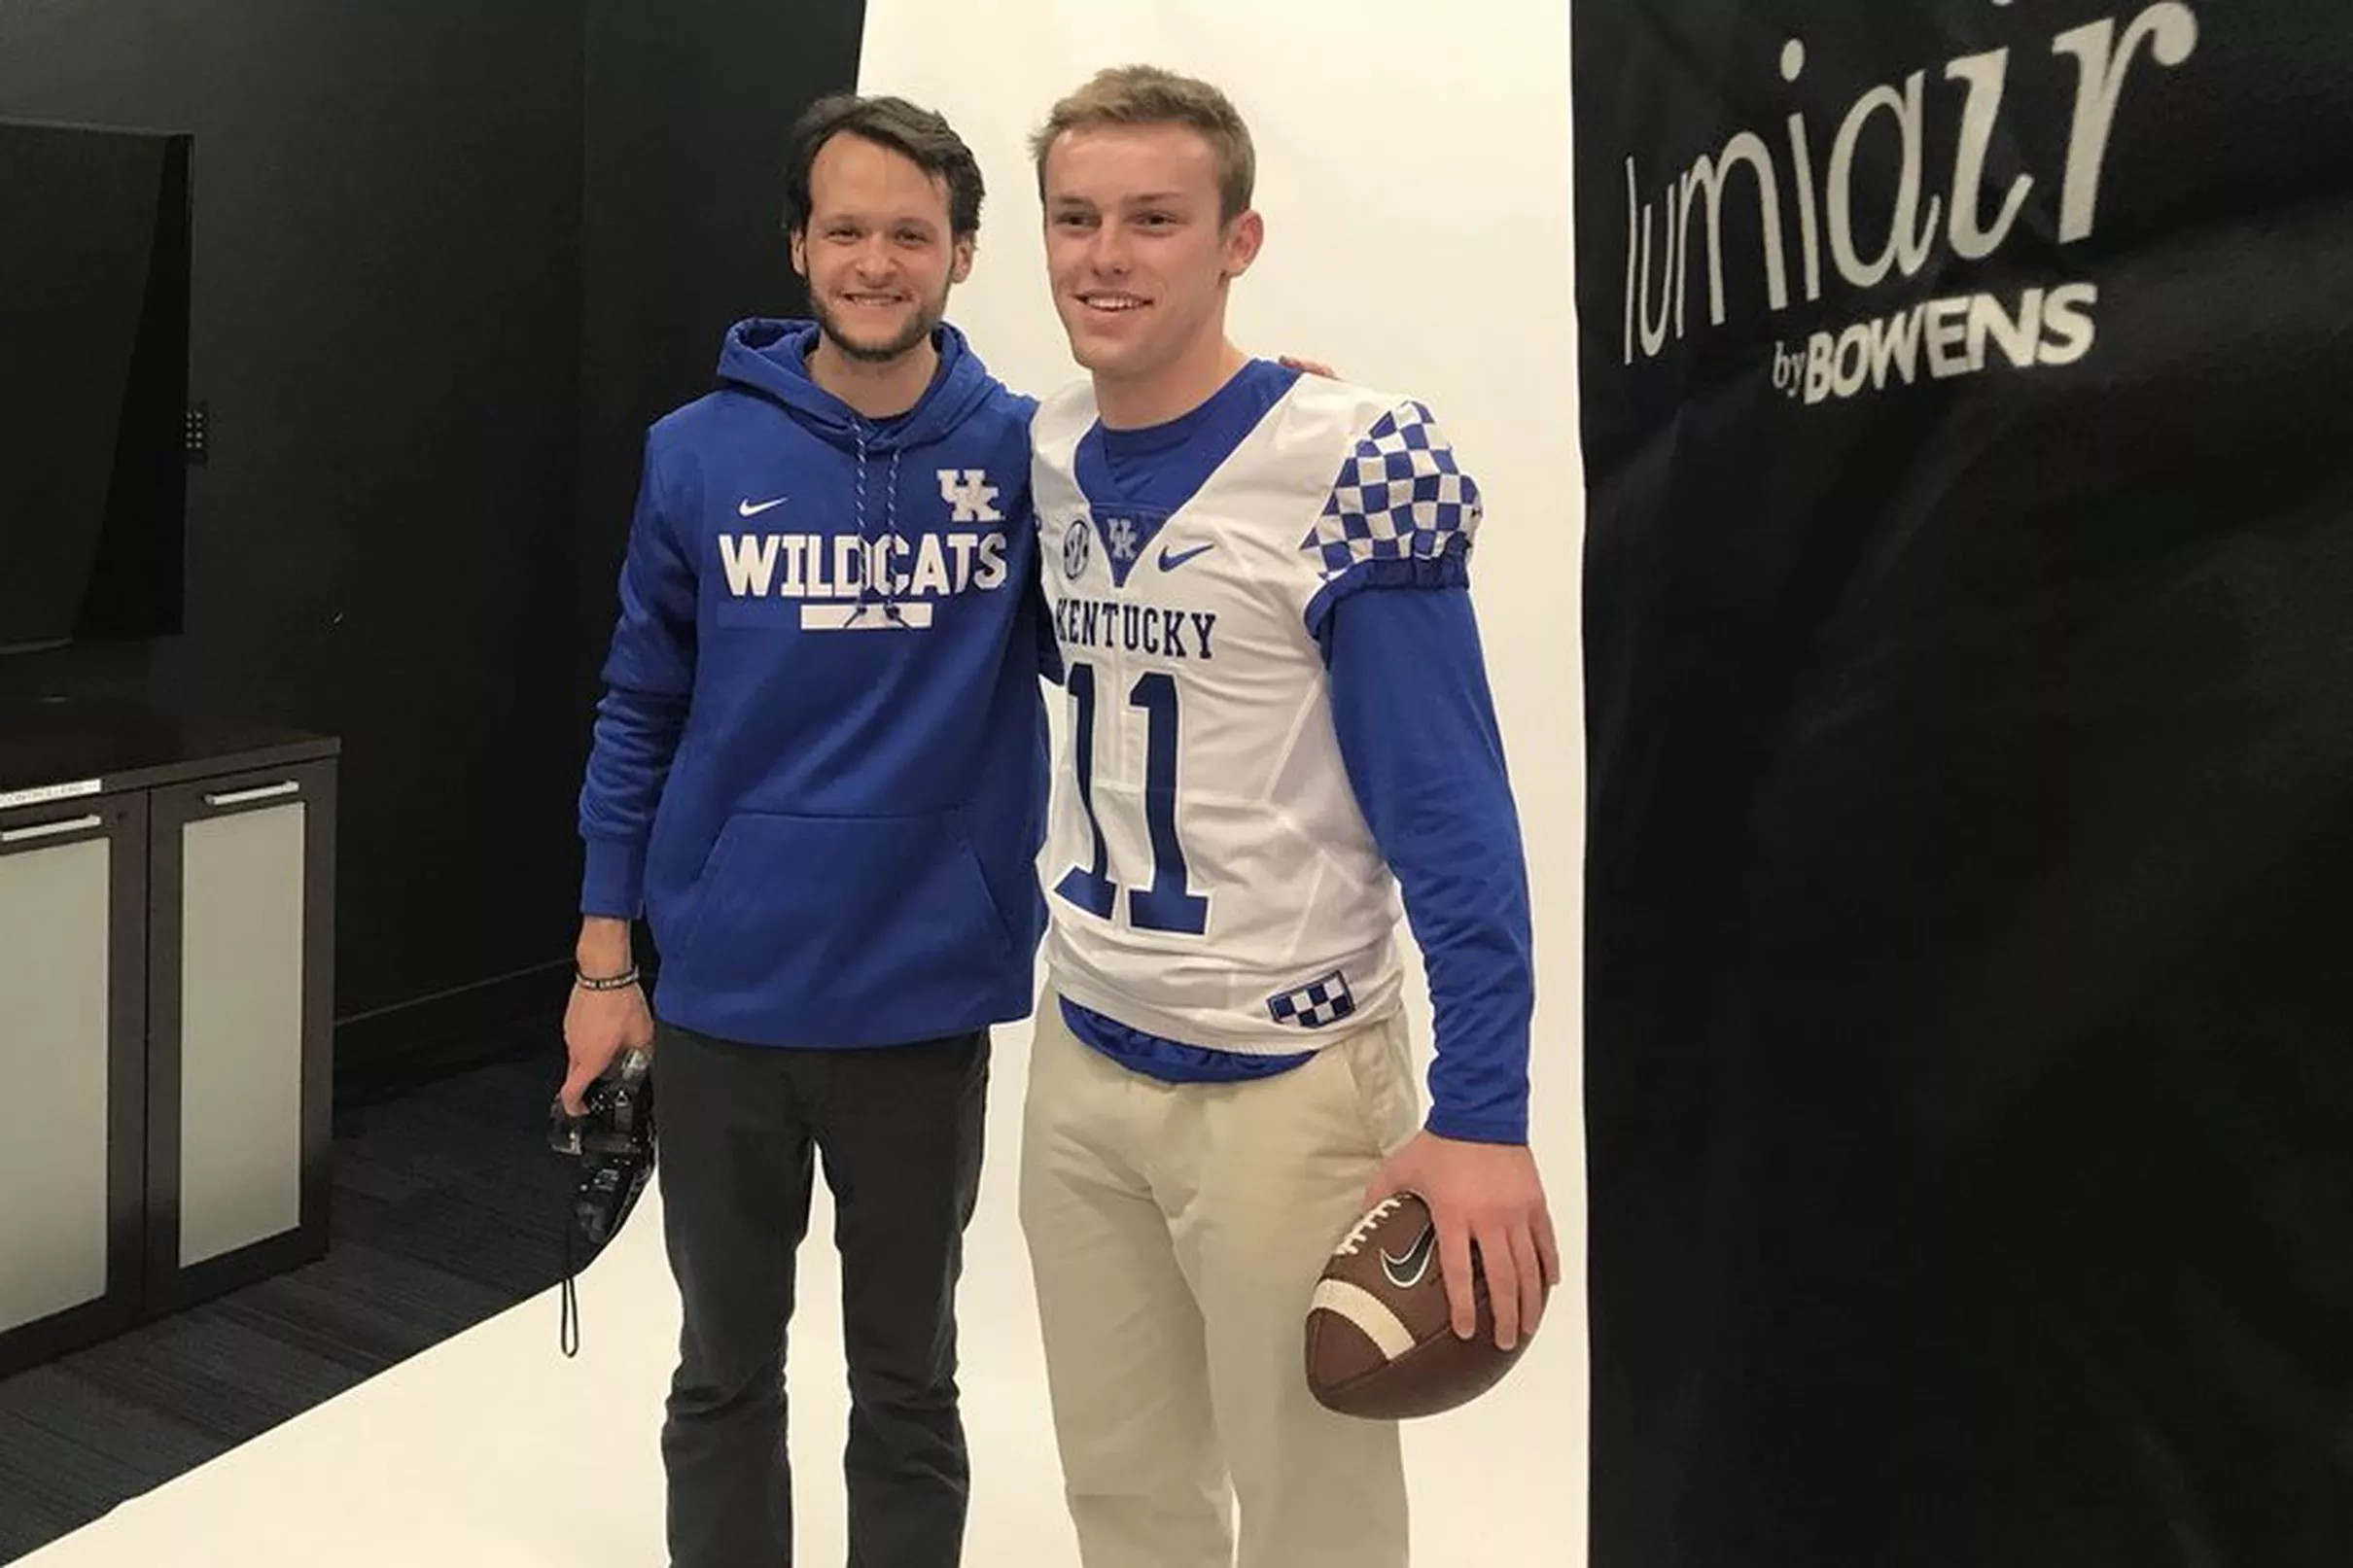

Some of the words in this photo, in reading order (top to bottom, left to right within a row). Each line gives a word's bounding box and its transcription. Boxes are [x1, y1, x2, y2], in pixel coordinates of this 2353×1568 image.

[1804, 283, 2097, 405] BOWENS
[719, 534, 1007, 596] WILDCATS
[1056, 598, 1216, 659] KENTUCKY
[1053, 663, 1210, 935] 11
